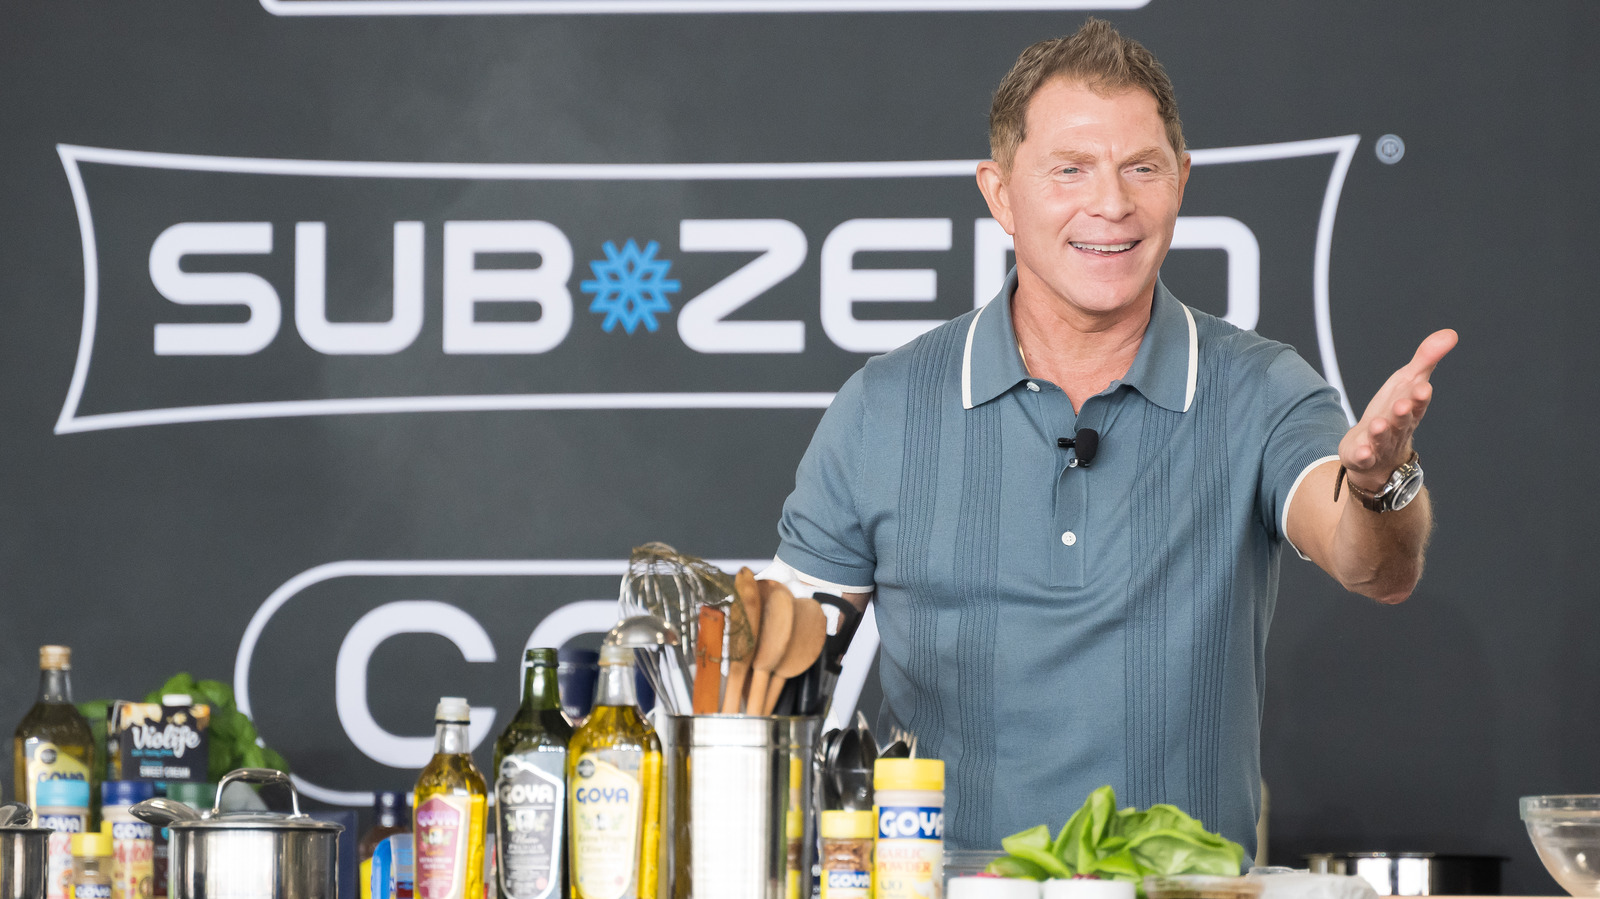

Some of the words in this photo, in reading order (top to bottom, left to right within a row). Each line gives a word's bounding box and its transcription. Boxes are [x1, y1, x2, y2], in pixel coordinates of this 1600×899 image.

[149, 221, 573, 355] SUB
[677, 216, 1261, 354] ZE
[132, 723, 201, 758] Violife
[500, 783, 555, 805] GOYA
[576, 787, 629, 806] GOYA
[878, 847, 926, 858] GARLIC
[878, 861, 932, 873] POWDER
[828, 873, 870, 889] GOYA
